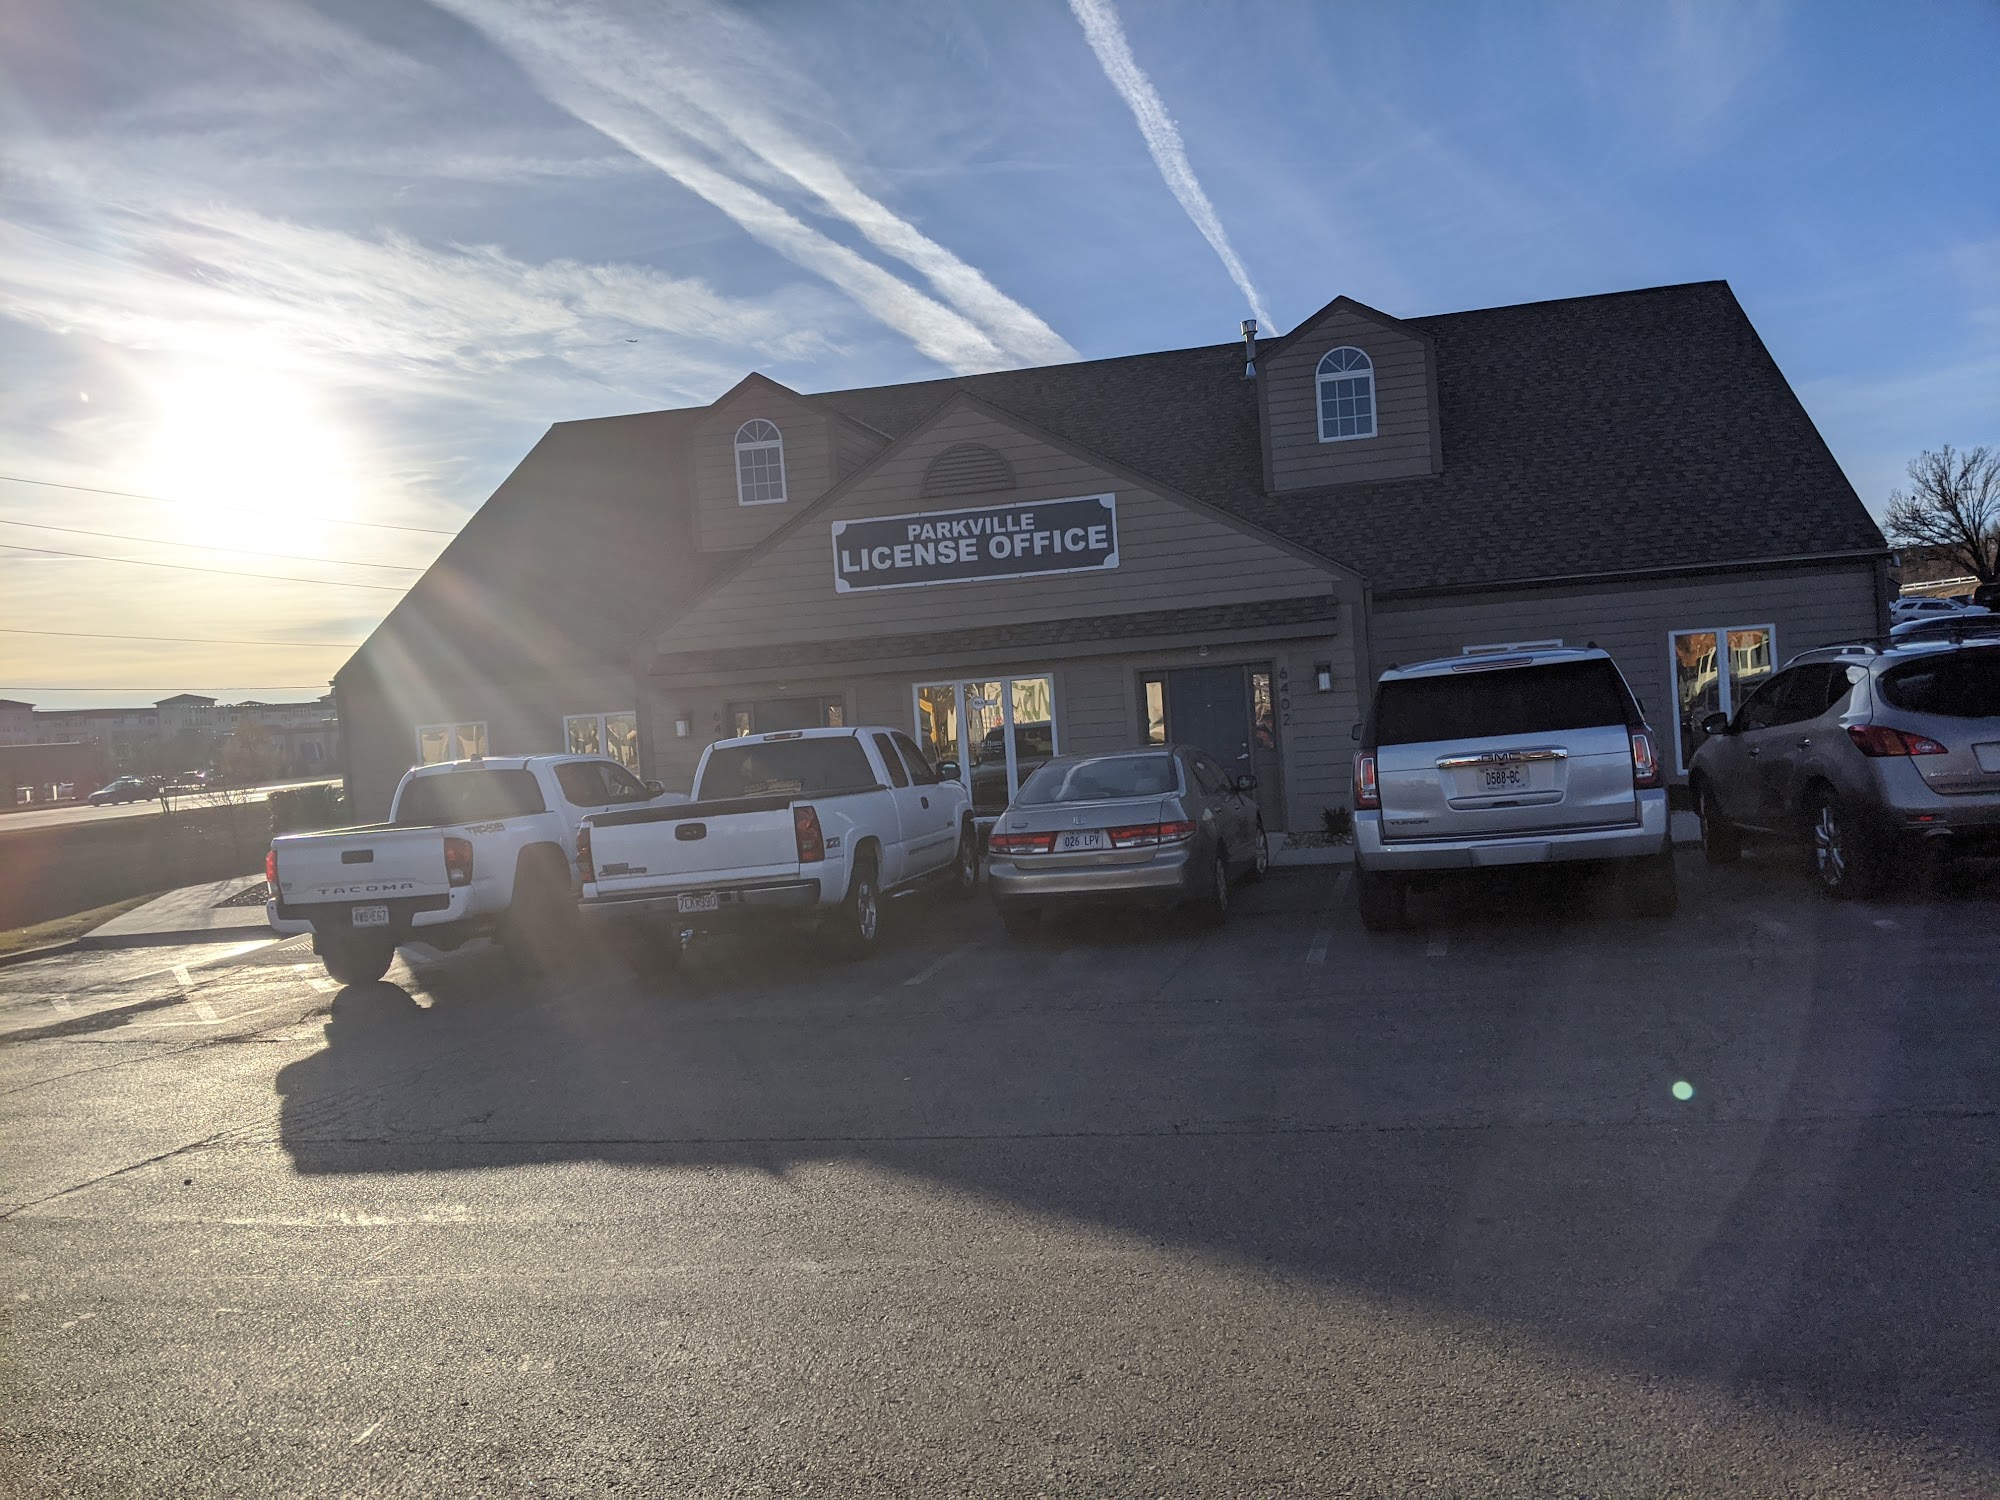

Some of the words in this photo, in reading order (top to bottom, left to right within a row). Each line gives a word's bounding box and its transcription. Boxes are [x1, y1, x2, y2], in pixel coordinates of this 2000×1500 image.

[908, 513, 1035, 541] PARKVILLE
[842, 538, 979, 573] LICENSE
[988, 525, 1108, 559] OFFICE
[1481, 752, 1522, 762] GMC
[1064, 837, 1080, 847] 026
[1084, 835, 1100, 846] LPV
[317, 883, 413, 895] TACOMA
